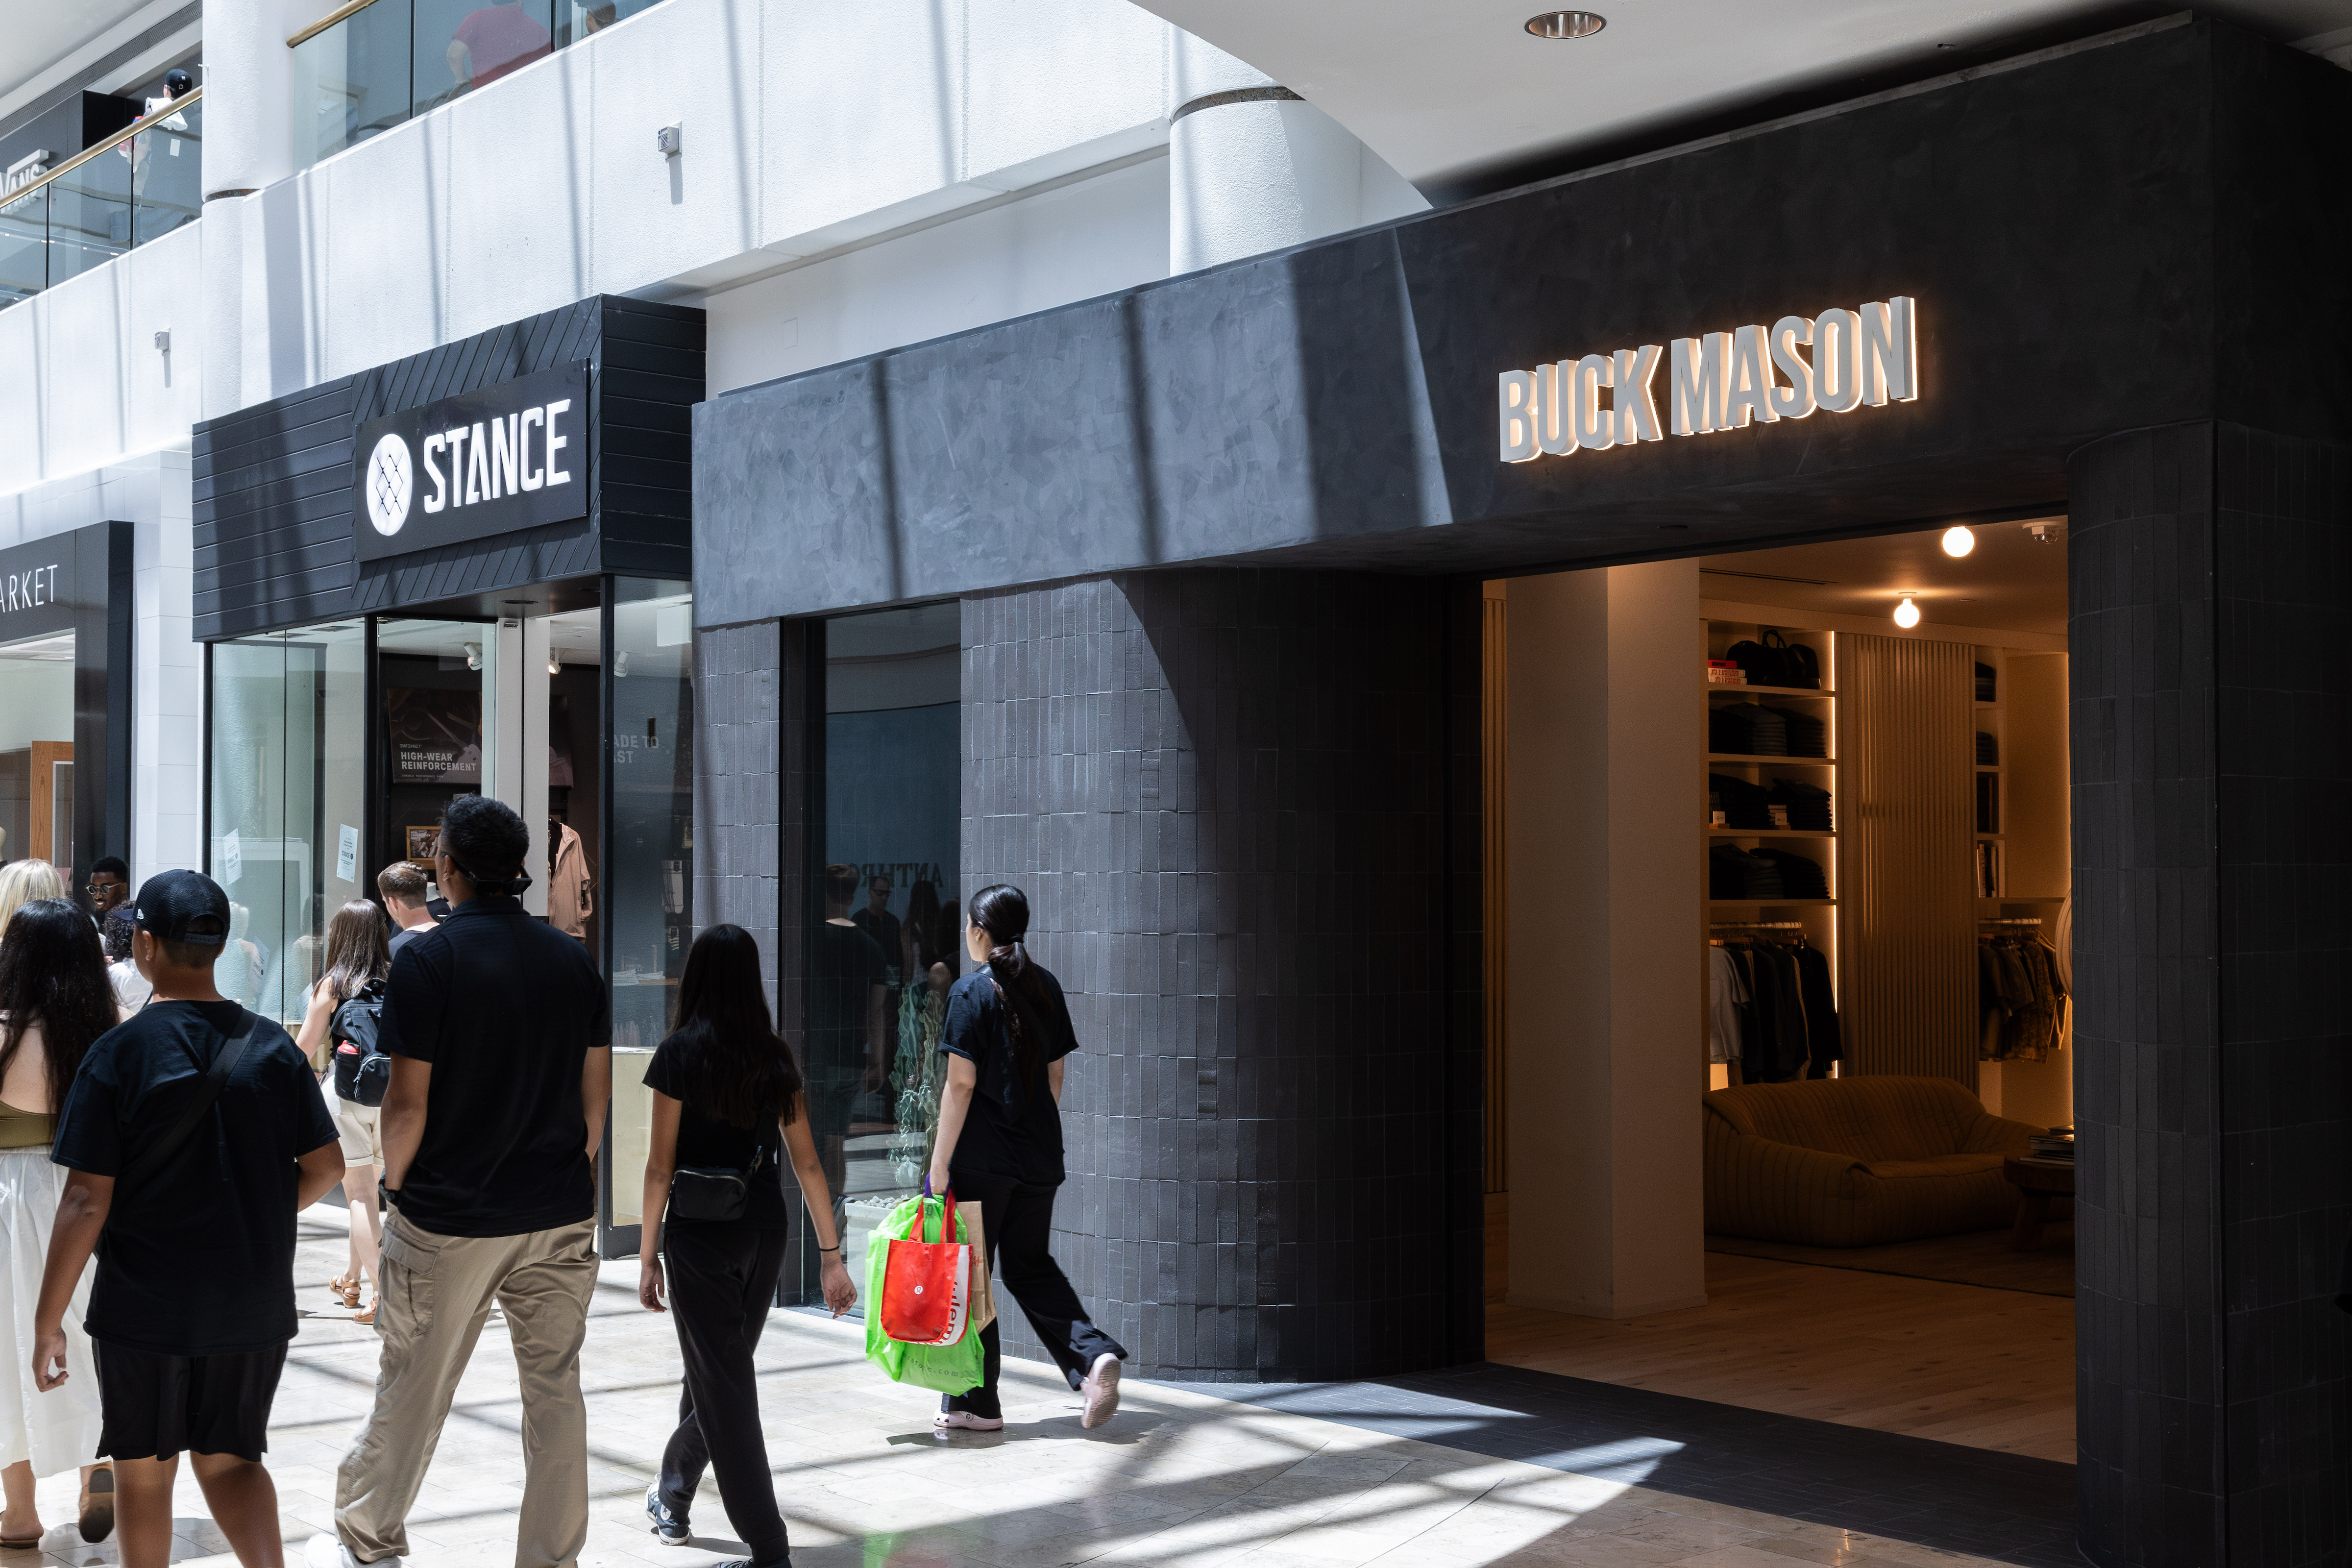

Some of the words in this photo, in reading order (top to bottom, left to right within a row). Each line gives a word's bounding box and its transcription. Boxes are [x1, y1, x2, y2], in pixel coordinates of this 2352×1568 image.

[1499, 344, 1664, 463] BUCK
[1670, 296, 1918, 436] MASON
[424, 398, 571, 514] STANCE
[642, 736, 659, 749] TO
[401, 752, 453, 761] HIGH-WEAR
[614, 750, 634, 763] ST
[401, 761, 476, 771] REINFORCEMENT
